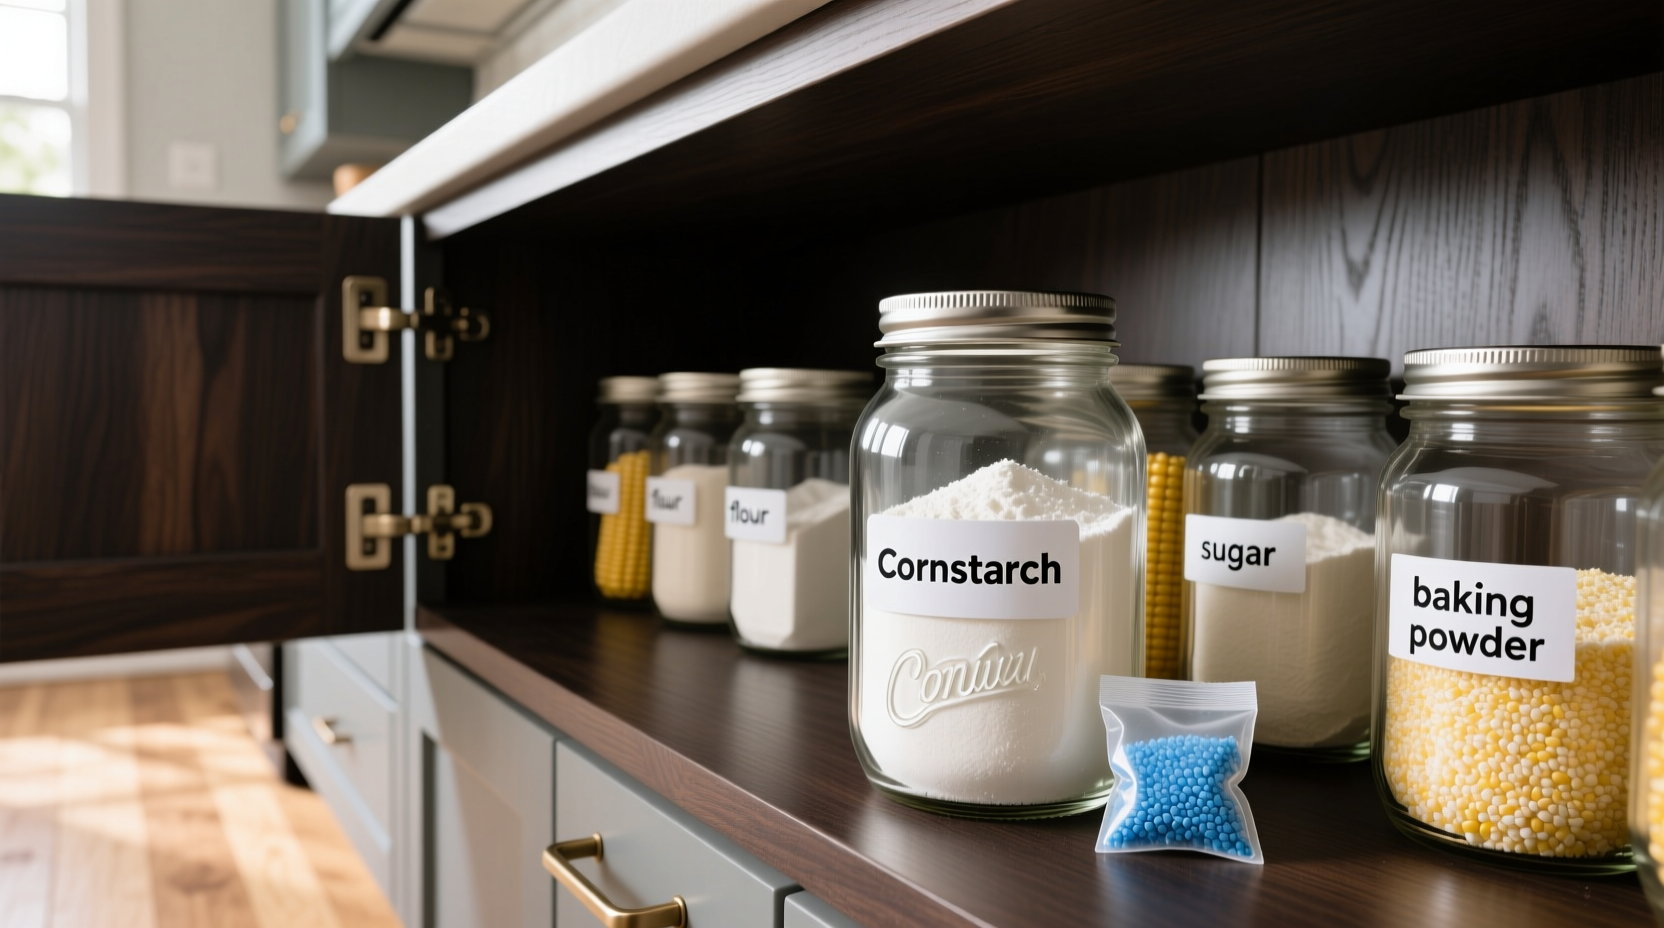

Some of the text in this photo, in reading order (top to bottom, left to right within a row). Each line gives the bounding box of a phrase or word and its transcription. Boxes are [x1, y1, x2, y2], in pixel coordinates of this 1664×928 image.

[730, 500, 769, 525] flour
[878, 548, 1061, 585] Cornstarch
[1201, 541, 1276, 571] sugar
[1413, 576, 1534, 628] baking
[1410, 623, 1545, 662] powder
